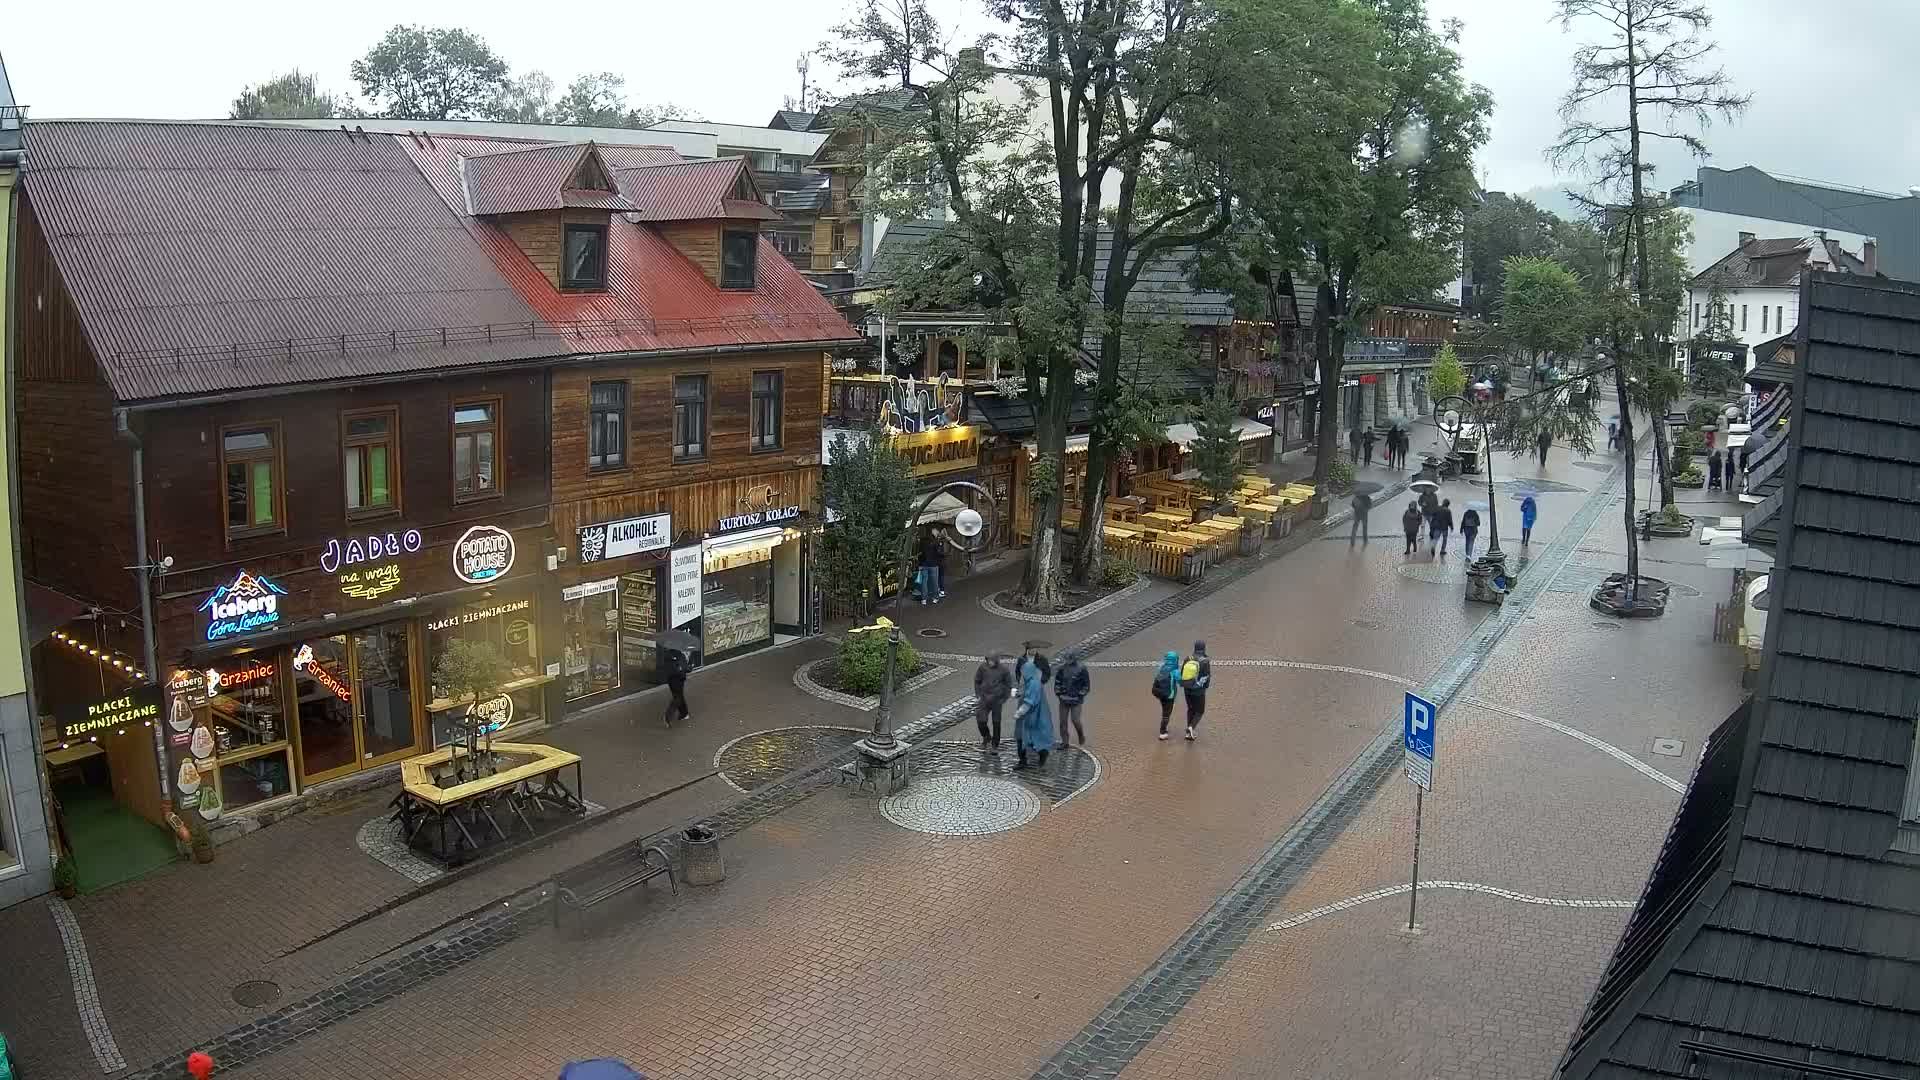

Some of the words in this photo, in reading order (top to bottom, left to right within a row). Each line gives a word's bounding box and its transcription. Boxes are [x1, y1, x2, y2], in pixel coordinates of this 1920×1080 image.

[720, 513, 760, 530] KURTOSZ
[766, 506, 799, 522] KOŁACZ
[612, 520, 657, 542] ALKOHOLE
[639, 536, 665, 548] REGIONALNE
[321, 530, 421, 572] JADŁO
[461, 535, 507, 558] POTATO
[341, 573, 360, 583] na
[365, 564, 399, 580] wagę
[464, 552, 506, 574] HOUSE
[463, 600, 529, 623] ZIEMNIACZANE
[207, 621, 237, 639] Góra
[236, 612, 279, 632] Lodowa
[172, 677, 203, 689] Iceberg
[220, 665, 273, 686] Grzaniec
[308, 660, 351, 701] Grzaniec
[88, 697, 131, 715] PLACKI
[1411, 700, 1428, 735] P
[65, 705, 157, 736] ZIEMNIACZANE
